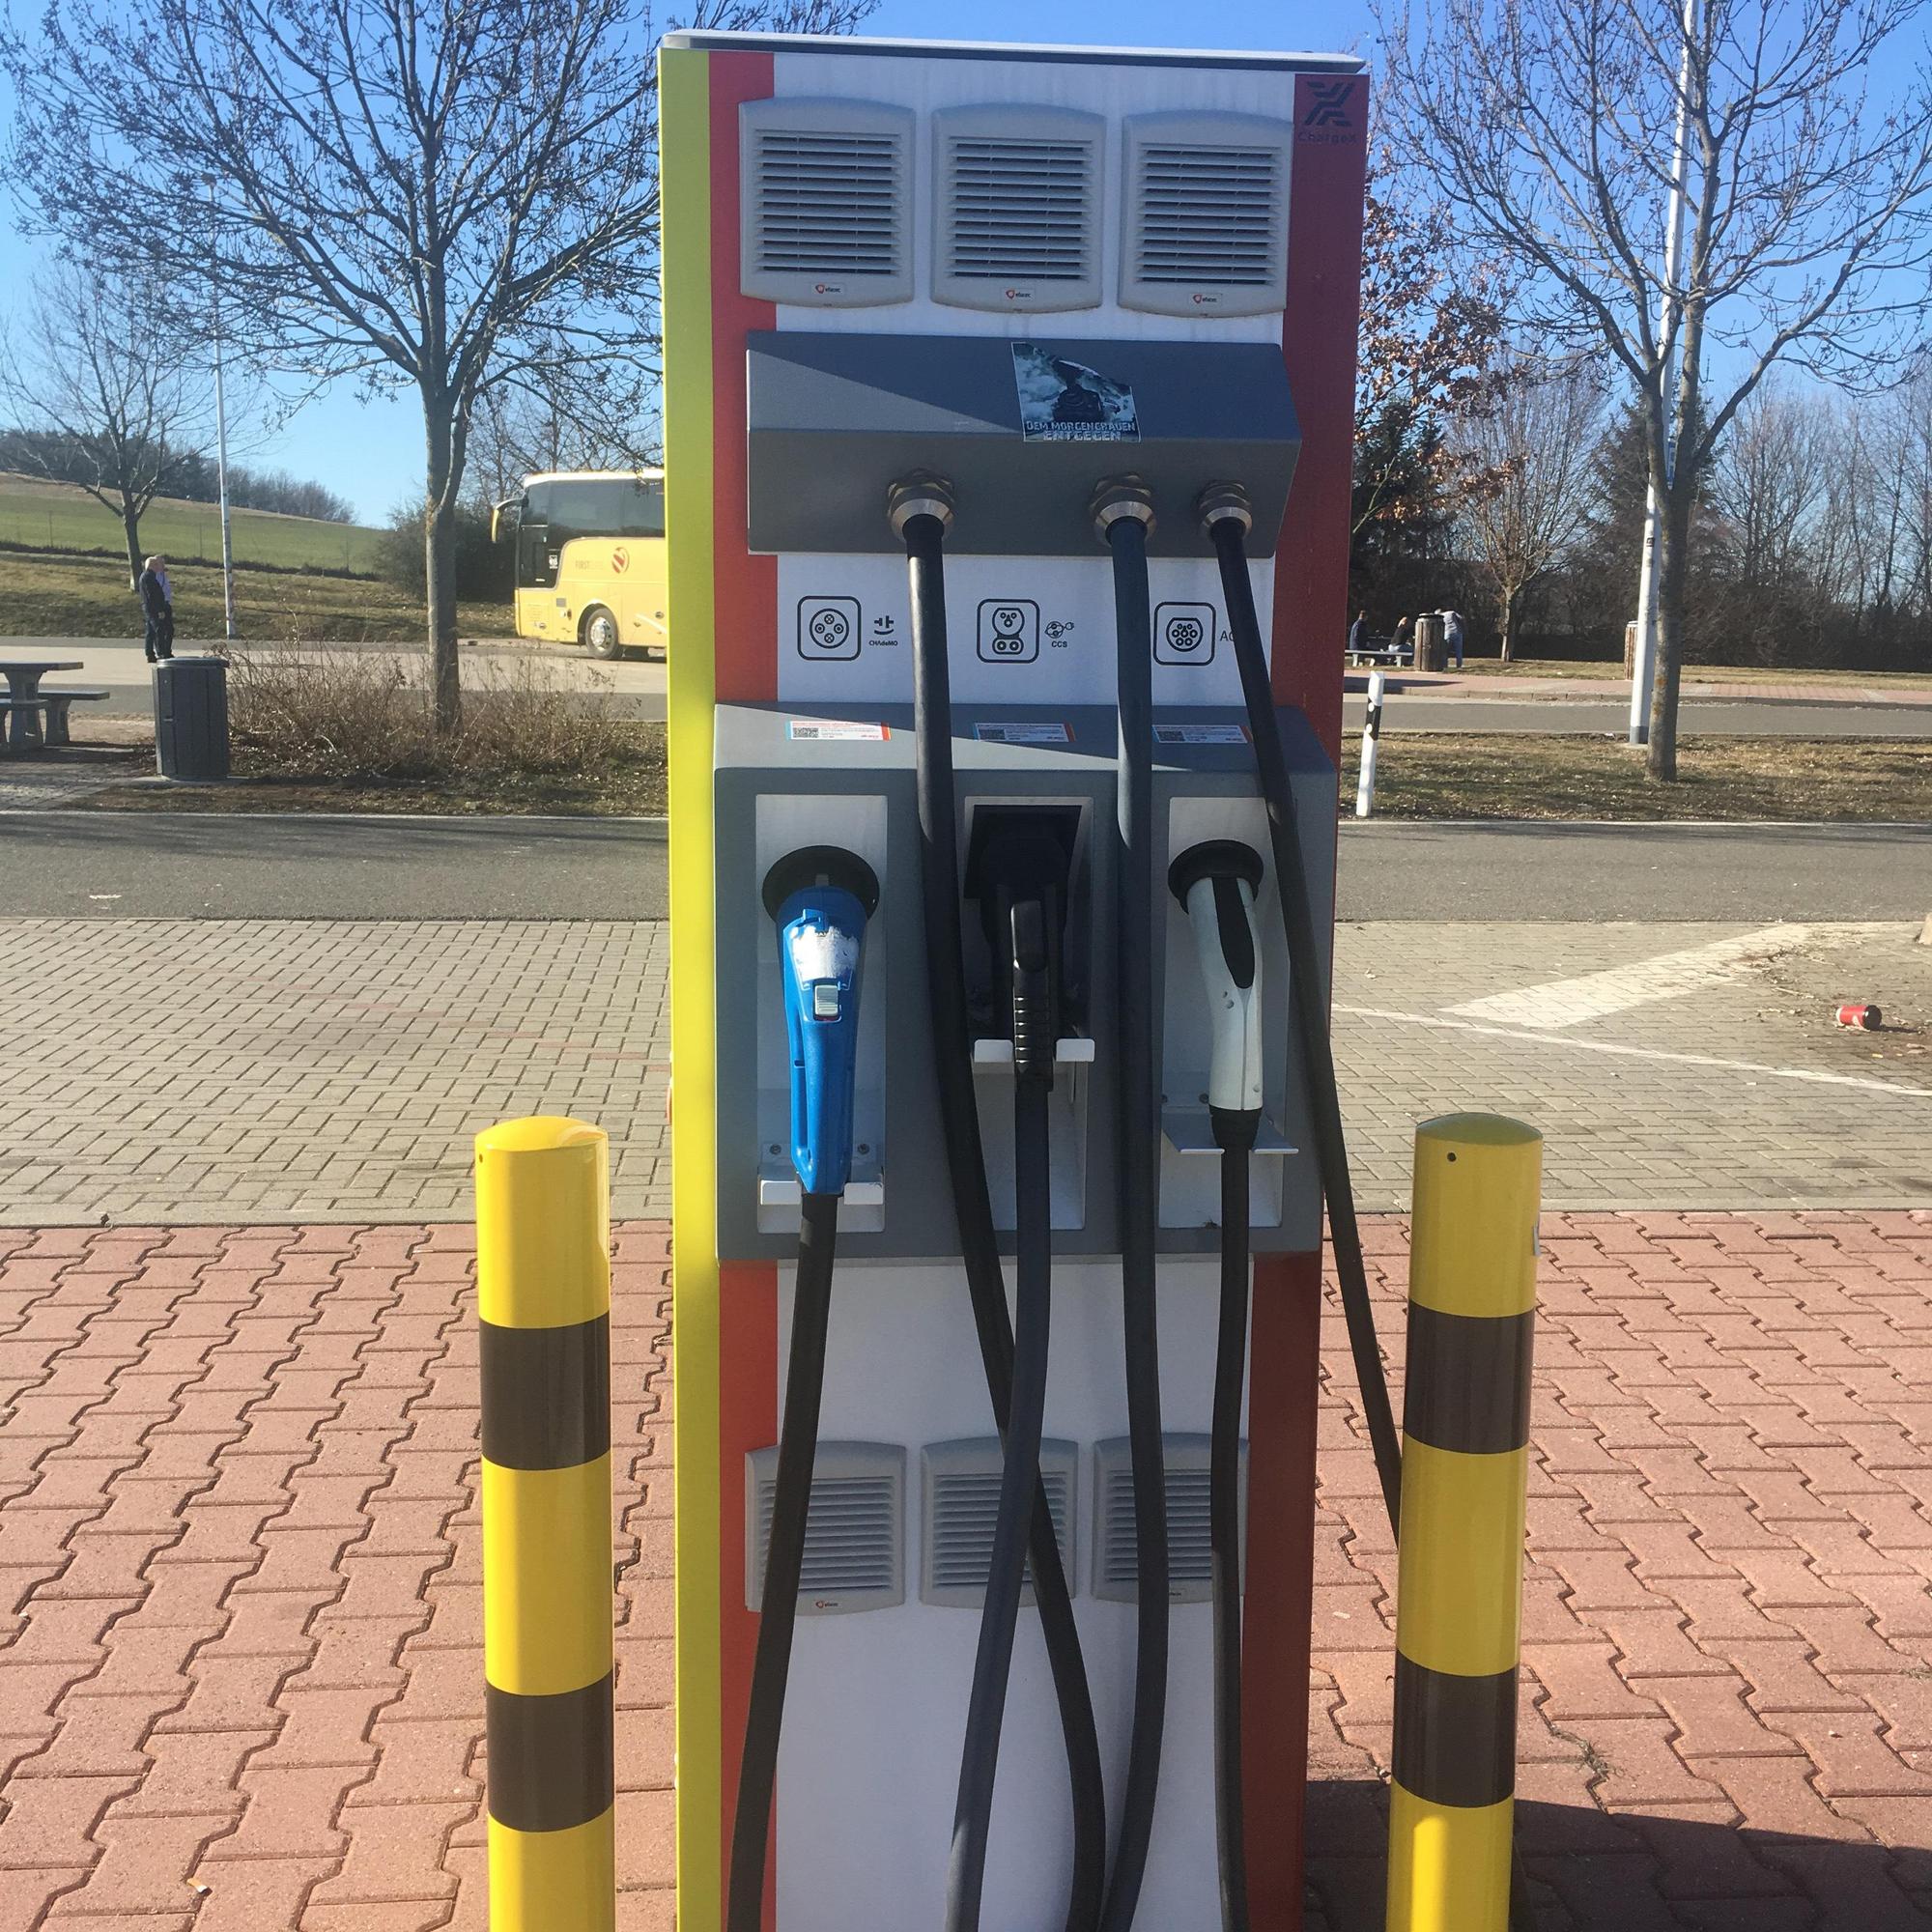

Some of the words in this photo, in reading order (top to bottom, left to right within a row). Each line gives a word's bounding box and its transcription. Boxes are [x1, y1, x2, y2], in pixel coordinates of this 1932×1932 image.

[1026, 420, 1049, 431] DEM
[1051, 421, 1136, 432] MORGENGRAUEN
[1042, 430, 1122, 440] ENTGEGEN
